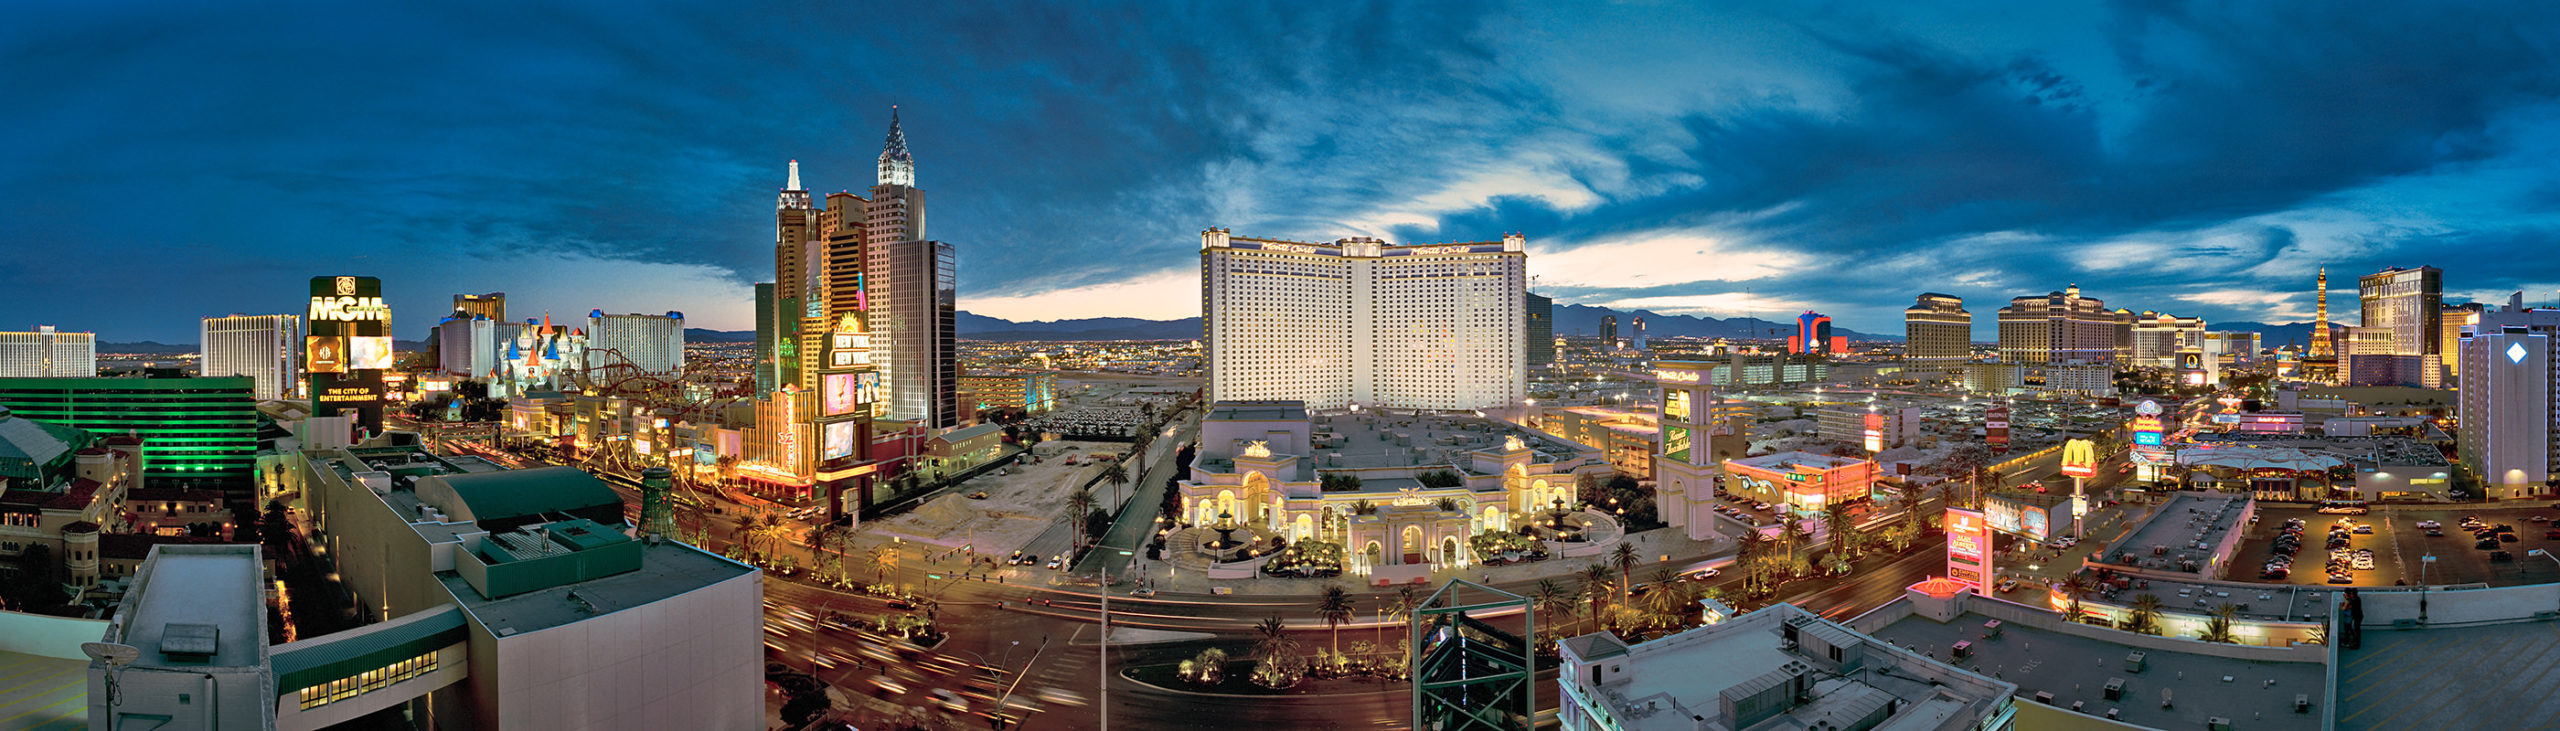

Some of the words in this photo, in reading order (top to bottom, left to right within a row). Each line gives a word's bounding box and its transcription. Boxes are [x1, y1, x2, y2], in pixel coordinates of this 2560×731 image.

[1260, 242, 1288, 251] Monte
[1290, 244, 1317, 254] Carlo
[1410, 246, 1437, 256] Monte
[1439, 245, 1471, 255] Carlo
[310, 296, 384, 321] MGM
[835, 335, 852, 348] NEW
[852, 335, 871, 348] YORK
[835, 351, 852, 365] NEW
[852, 351, 871, 365] YORK
[1656, 370, 1677, 381] Monte
[1677, 371, 1700, 383] Carlo
